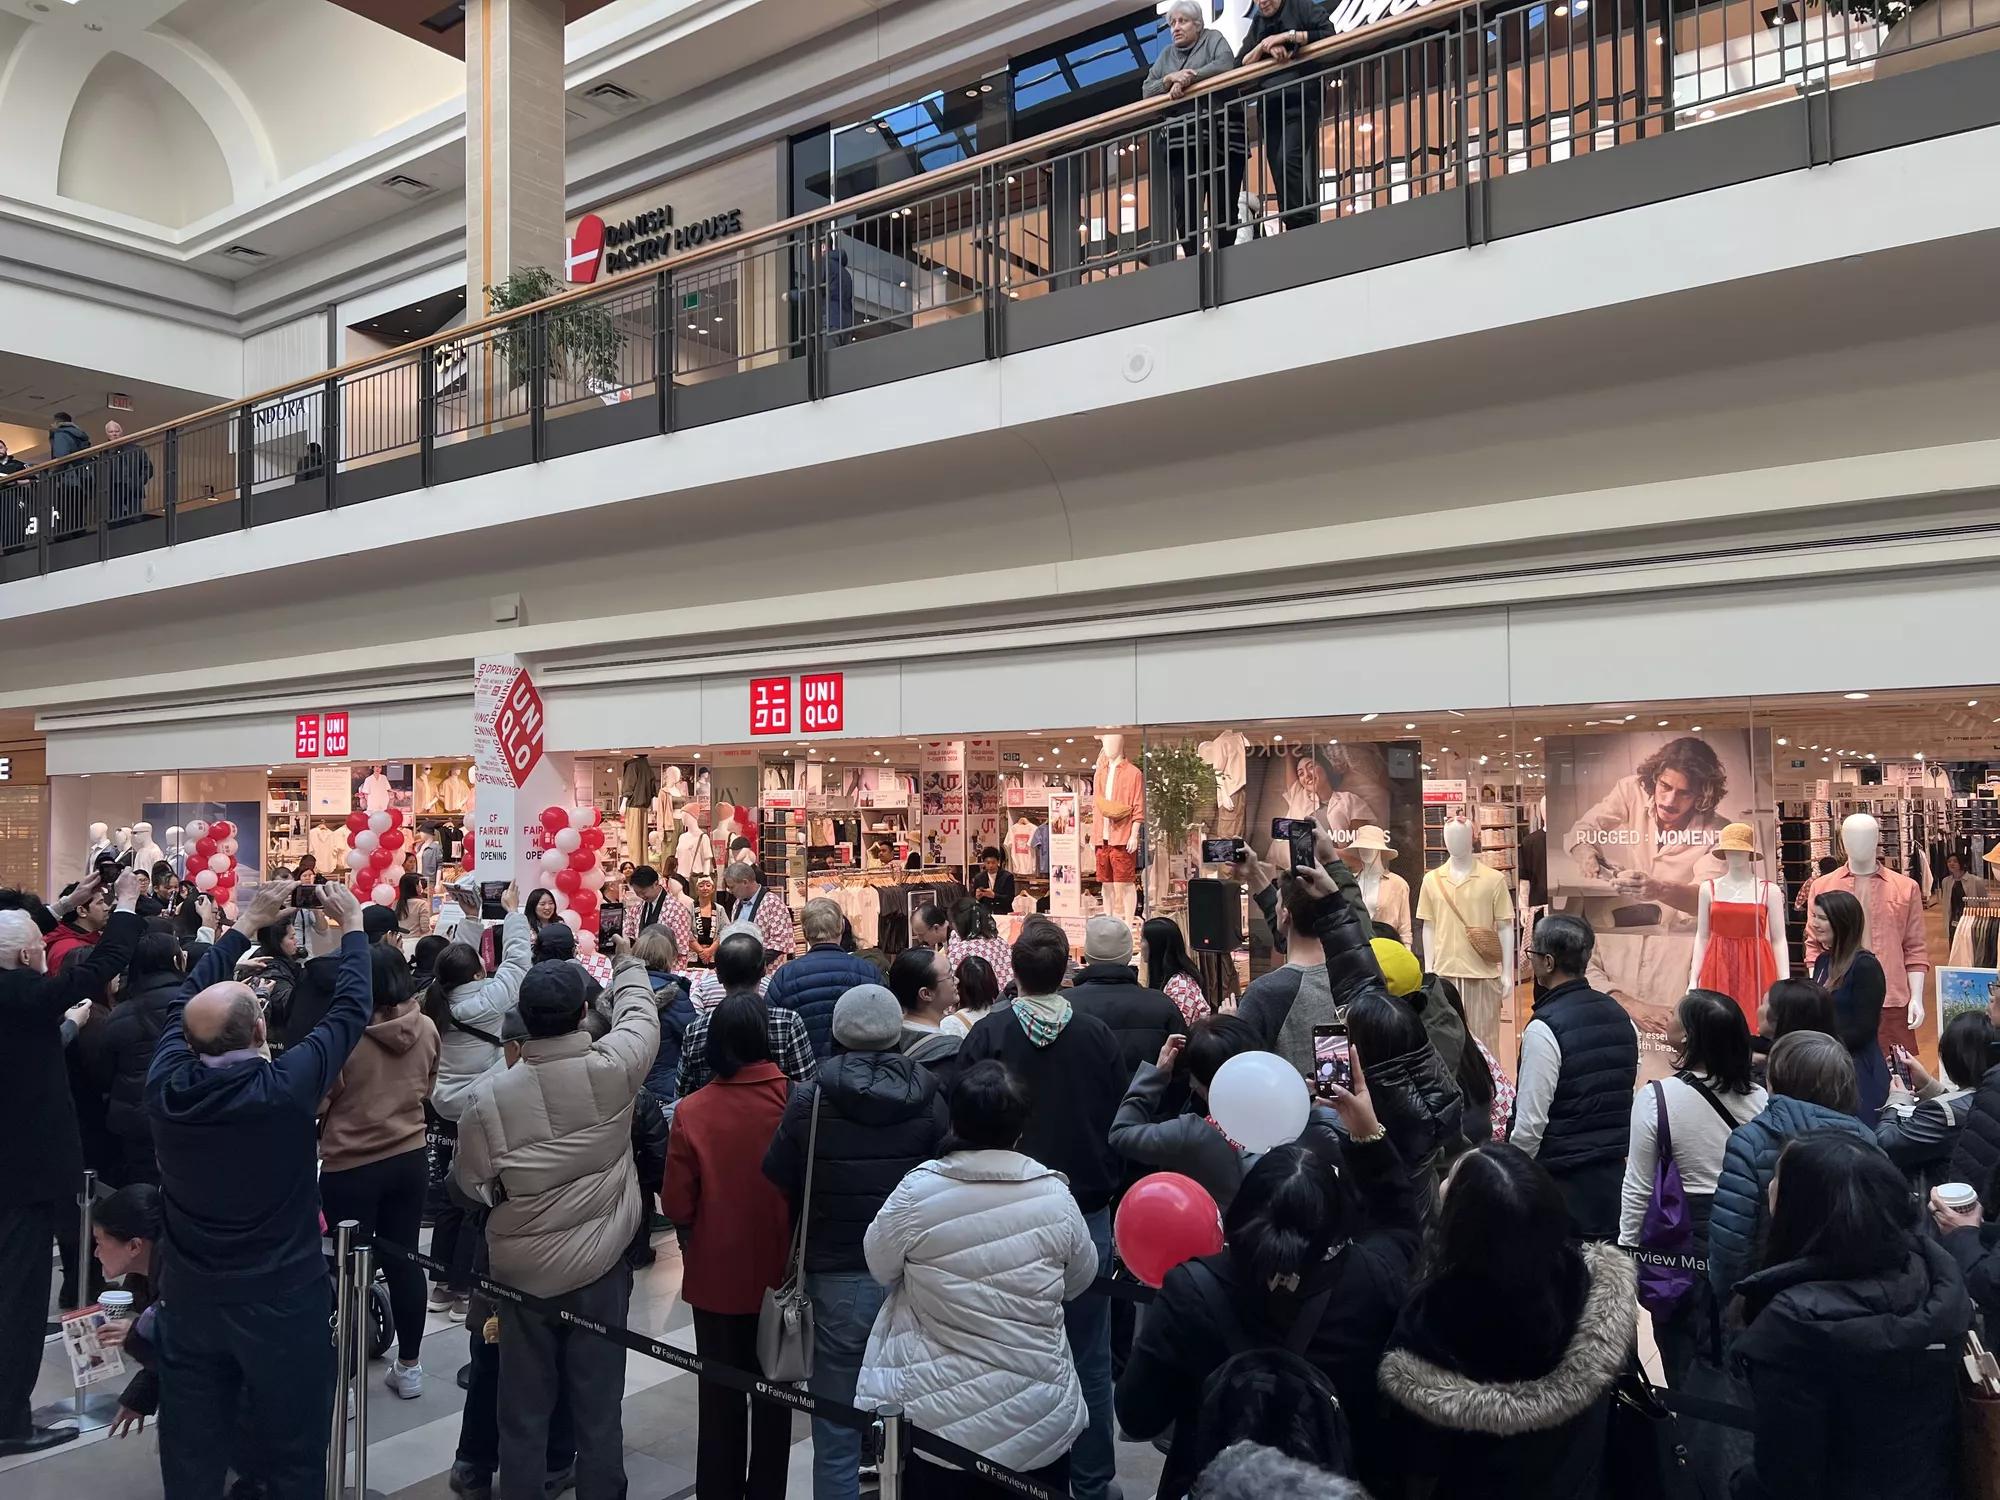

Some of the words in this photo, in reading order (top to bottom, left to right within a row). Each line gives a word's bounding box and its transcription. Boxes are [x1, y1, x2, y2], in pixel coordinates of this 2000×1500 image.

[605, 204, 673, 247] DANISH
[606, 232, 671, 273] PASTRY
[675, 208, 741, 250] HOUSE
[252, 396, 306, 429] NDORA
[474, 663, 487, 688] OPE
[486, 664, 520, 677] OPENING
[488, 678, 514, 724] OPENING
[805, 681, 835, 702] UNI
[513, 682, 544, 746] UNI
[805, 704, 838, 728] QLO
[327, 718, 344, 734] UNI
[326, 735, 346, 753] QLO
[501, 709, 531, 770] QLO
[492, 739, 516, 789] OPENING
[489, 814, 498, 823] CF
[479, 827, 509, 836] FAIRVIEW
[523, 826, 544, 835] FAIR
[1327, 829, 1391, 843] MOMS
[1576, 830, 1640, 845] RUGGED
[1654, 830, 1722, 845] MOMENT
[485, 839, 503, 848] MALL
[480, 852, 507, 861] OPENING
[1639, 1040, 1651, 1050] ith
[1626, 1248, 1676, 1266] irview
[1681, 1255, 1711, 1272] Mal
[570, 1313, 594, 1330] Fairview
[594, 1322, 607, 1334] Mall
[662, 1348, 688, 1365] Fairview
[689, 1358, 703, 1371] Mall
[768, 1386, 798, 1403] Fairview
[800, 1395, 815, 1408] Mall
[991, 1466, 1027, 1492] Fairview
[1029, 1484, 1049, 1500] Mall
